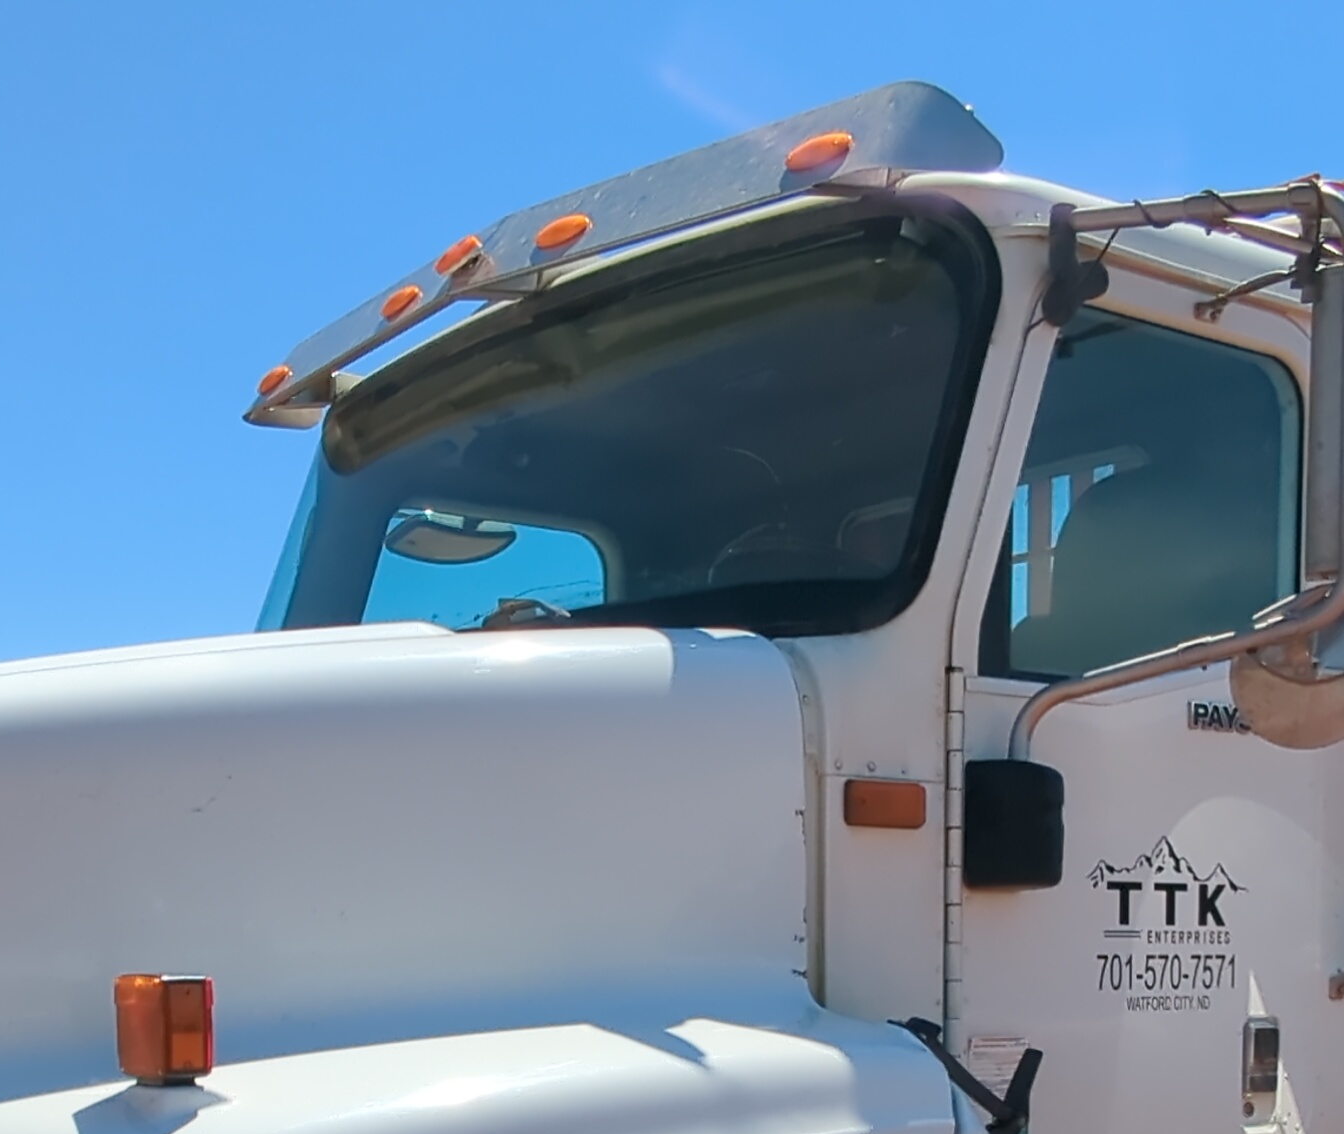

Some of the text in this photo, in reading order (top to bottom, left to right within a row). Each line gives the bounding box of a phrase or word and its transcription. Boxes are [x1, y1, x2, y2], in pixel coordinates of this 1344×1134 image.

[1107, 881, 1226, 926] TTK
[1147, 930, 1231, 945] ENTERPRISES
[1096, 954, 1236, 991] 701-570-7571
[1126, 995, 1172, 1011] WATFORD
[1197, 995, 1211, 1010] ND
